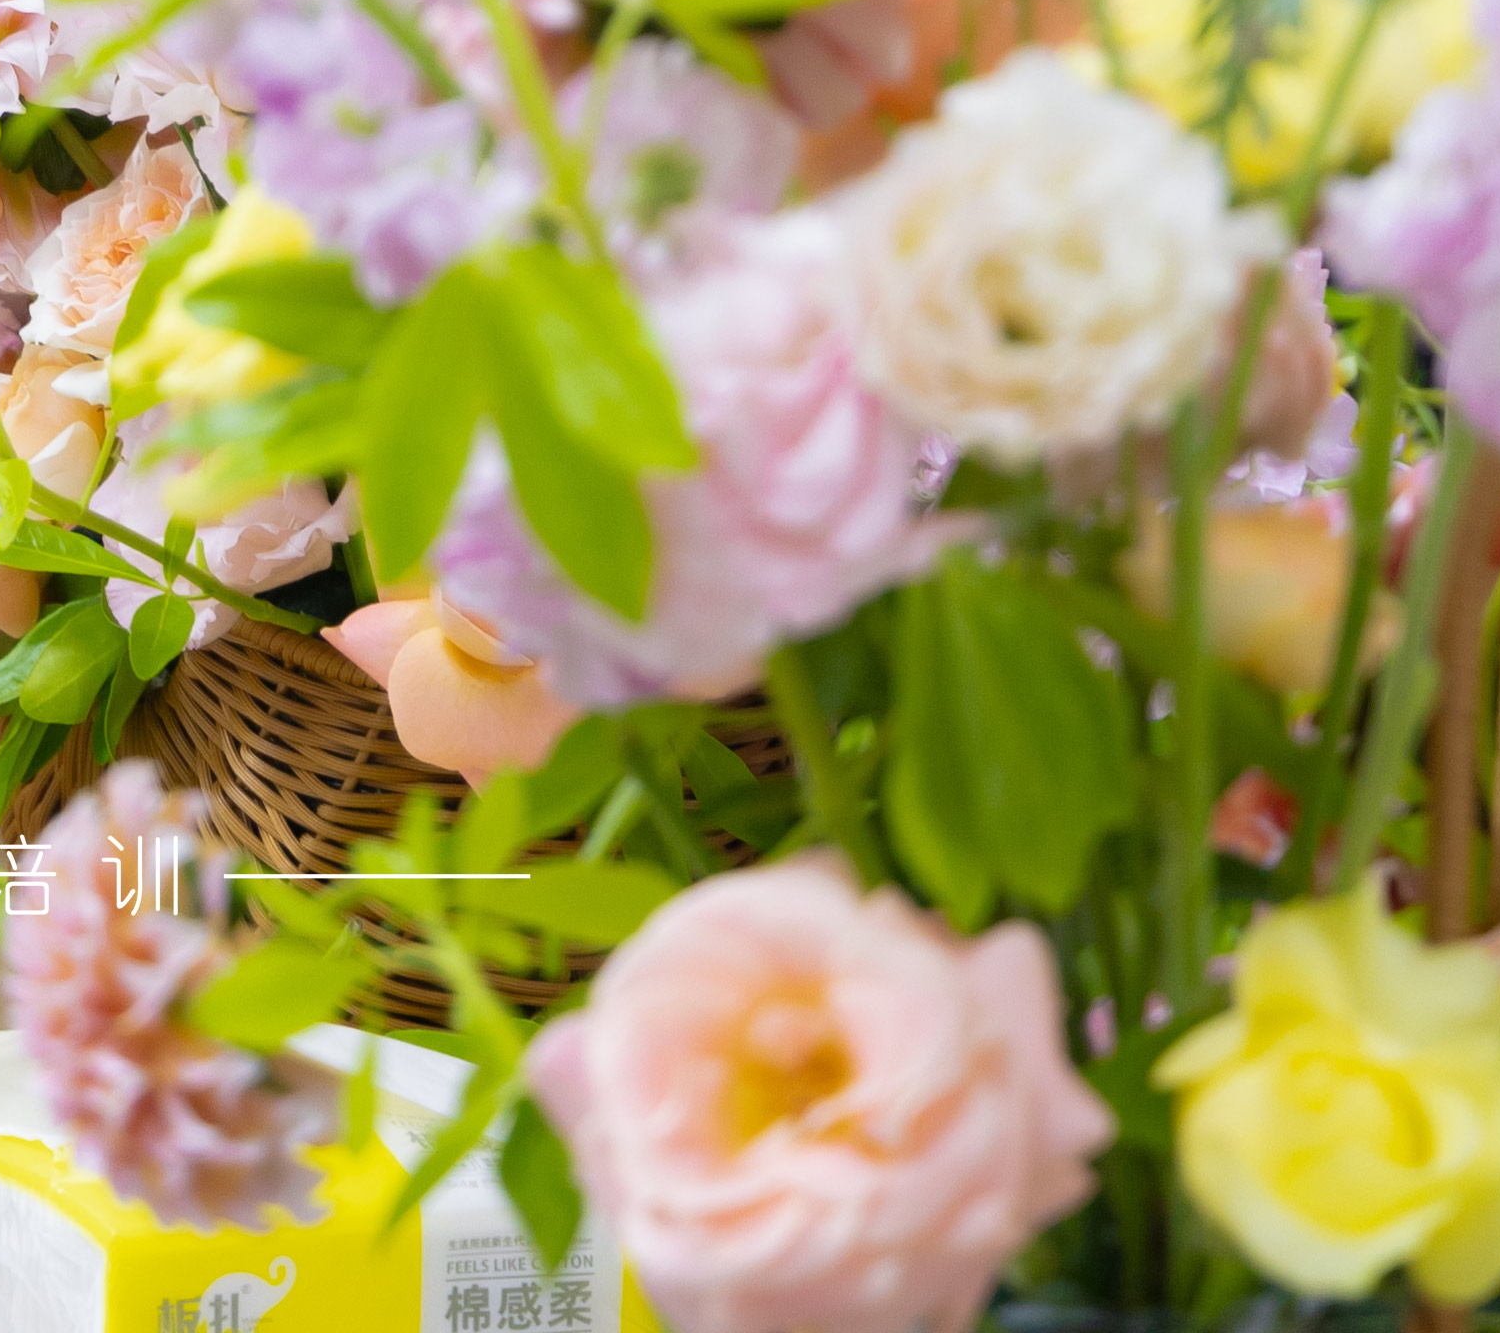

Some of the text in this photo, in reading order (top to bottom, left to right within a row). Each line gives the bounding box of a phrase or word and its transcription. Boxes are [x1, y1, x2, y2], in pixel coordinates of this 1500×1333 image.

[446, 1253, 594, 1275] FEELS LIKE CTON
[445, 1280, 593, 1333] 棉感柔
